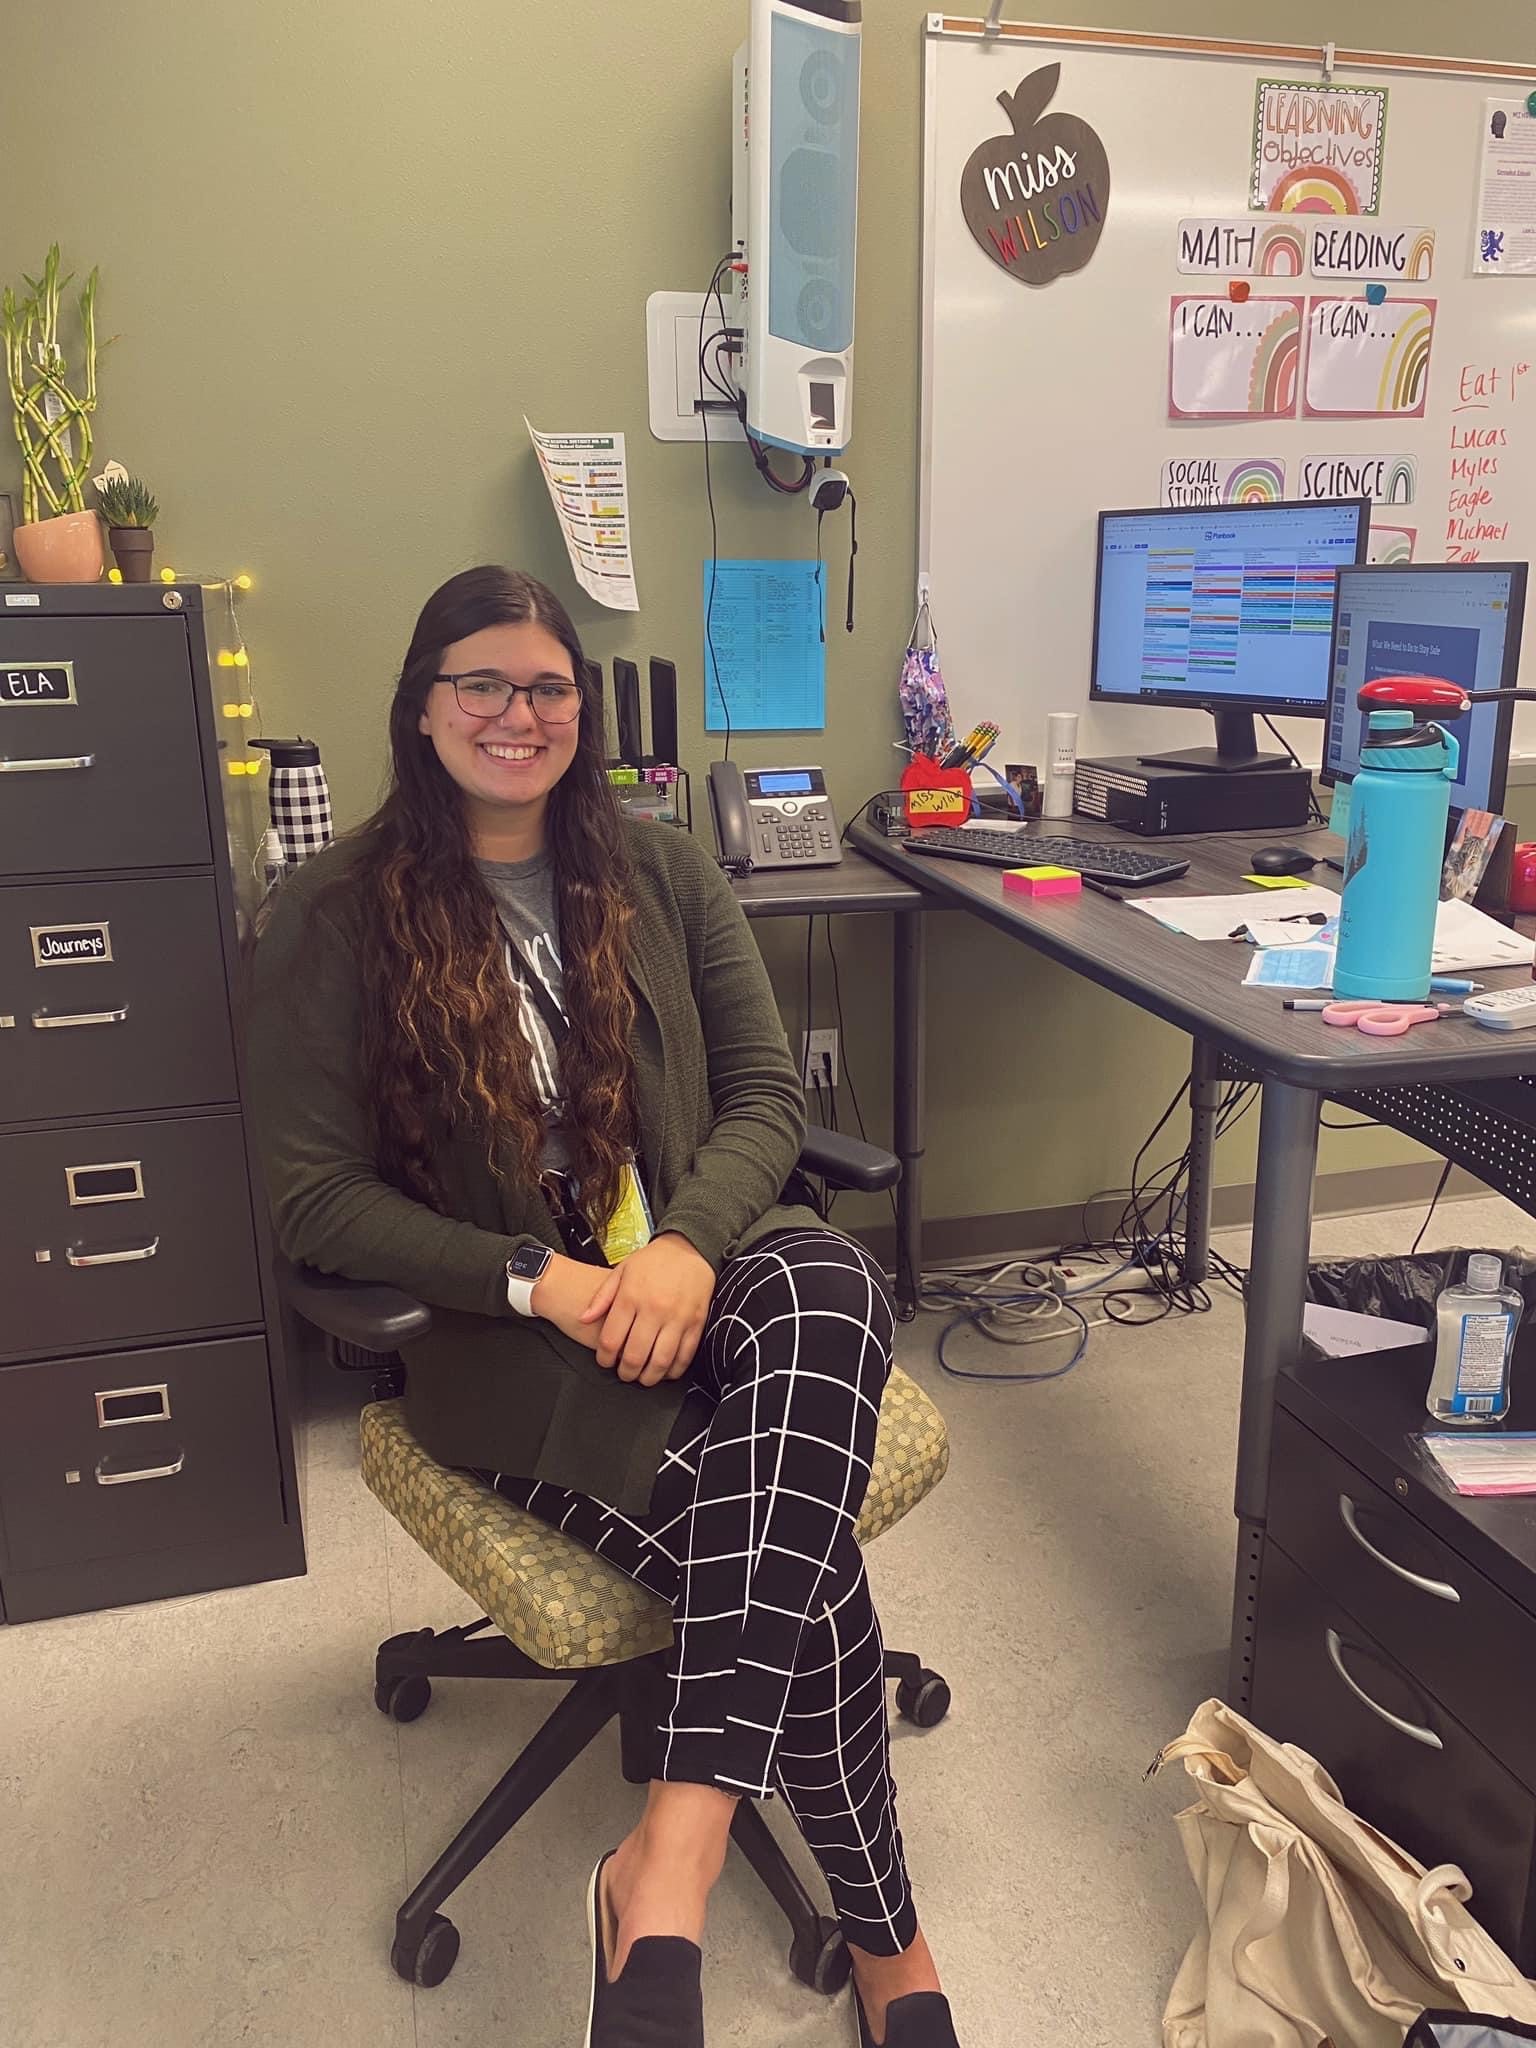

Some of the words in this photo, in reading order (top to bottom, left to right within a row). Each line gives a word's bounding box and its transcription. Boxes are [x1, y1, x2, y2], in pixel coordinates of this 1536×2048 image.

[1265, 92, 1373, 140] LEARNING
[986, 182, 1101, 265] WILSON
[1181, 226, 1256, 268] MATH
[1313, 230, 1407, 272] READING
[1181, 306, 1188, 335] I
[1319, 307, 1325, 335] I
[1459, 364, 1501, 402] Eat
[1450, 425, 1507, 450] Lucas
[1168, 460, 1219, 485] SOCIAL
[1303, 461, 1385, 498] SCIENCE
[1451, 457, 1498, 486] Myles
[1168, 485, 1221, 507] STUDIES
[1448, 485, 1492, 517] Eagle
[1446, 518, 1509, 541] Michael
[7, 672, 54, 697] ELA
[40, 935, 104, 958] Journeys
